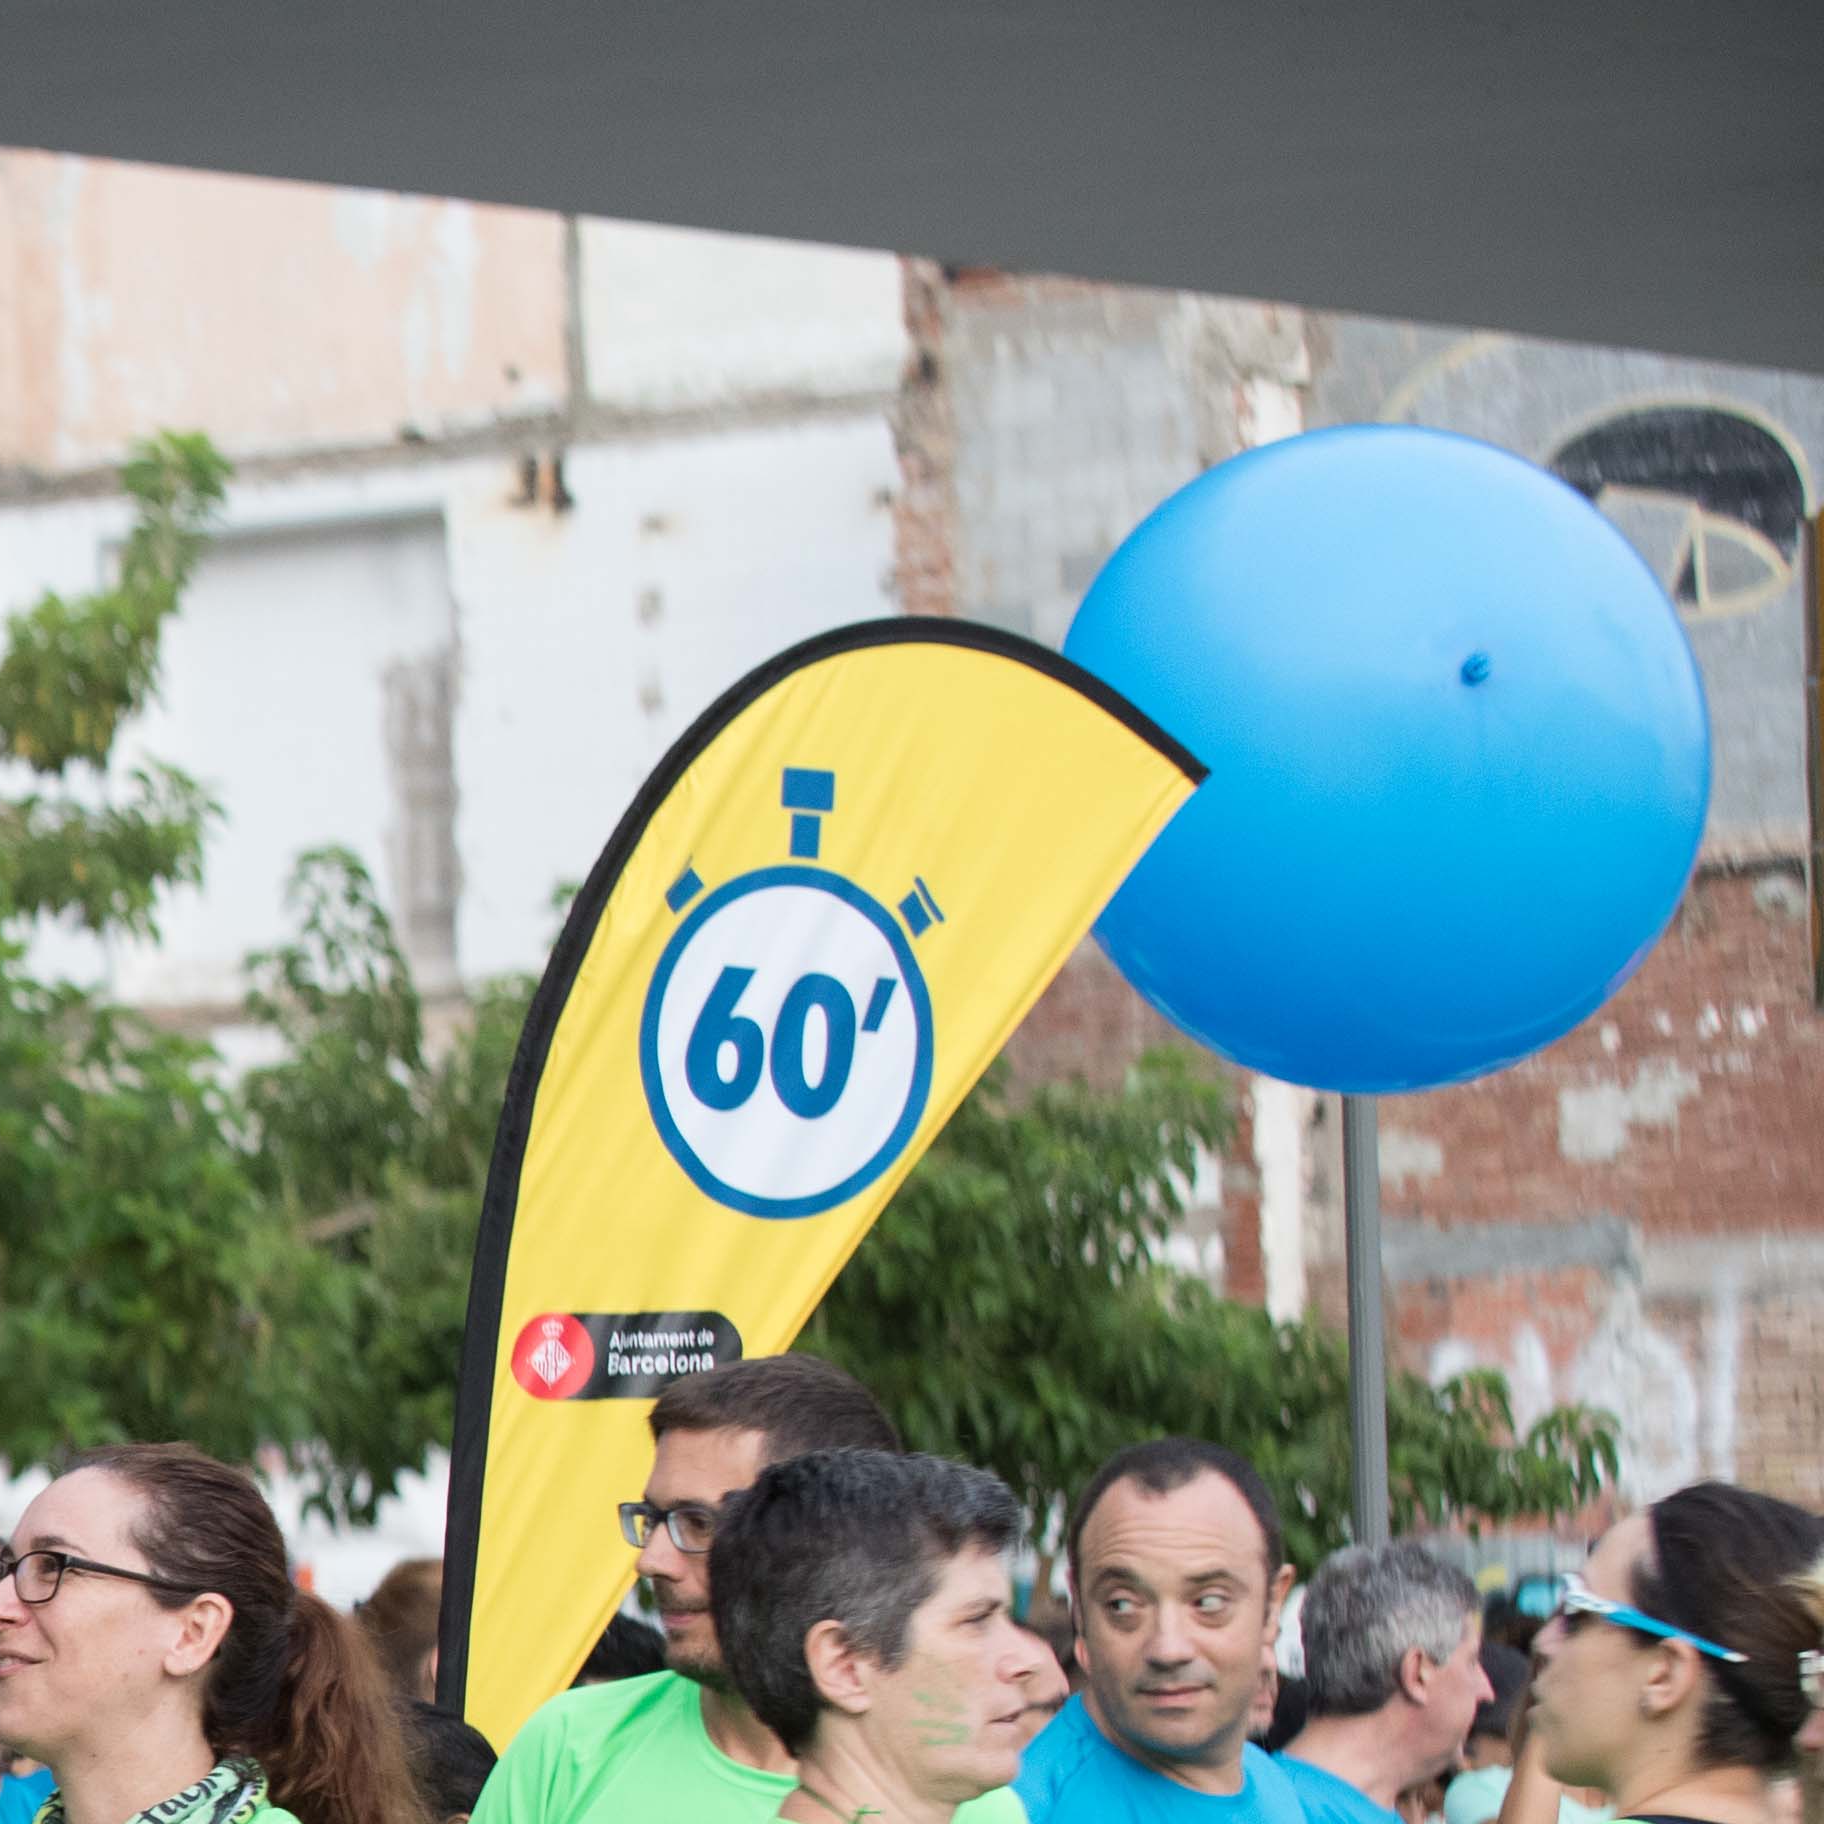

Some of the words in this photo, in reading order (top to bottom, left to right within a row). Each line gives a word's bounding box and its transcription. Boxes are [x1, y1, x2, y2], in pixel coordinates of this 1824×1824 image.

[684, 964, 896, 1120] 60'
[609, 1330, 696, 1353] Ajuntament
[697, 1328, 715, 1347] de
[607, 1350, 715, 1377] Barcelona
